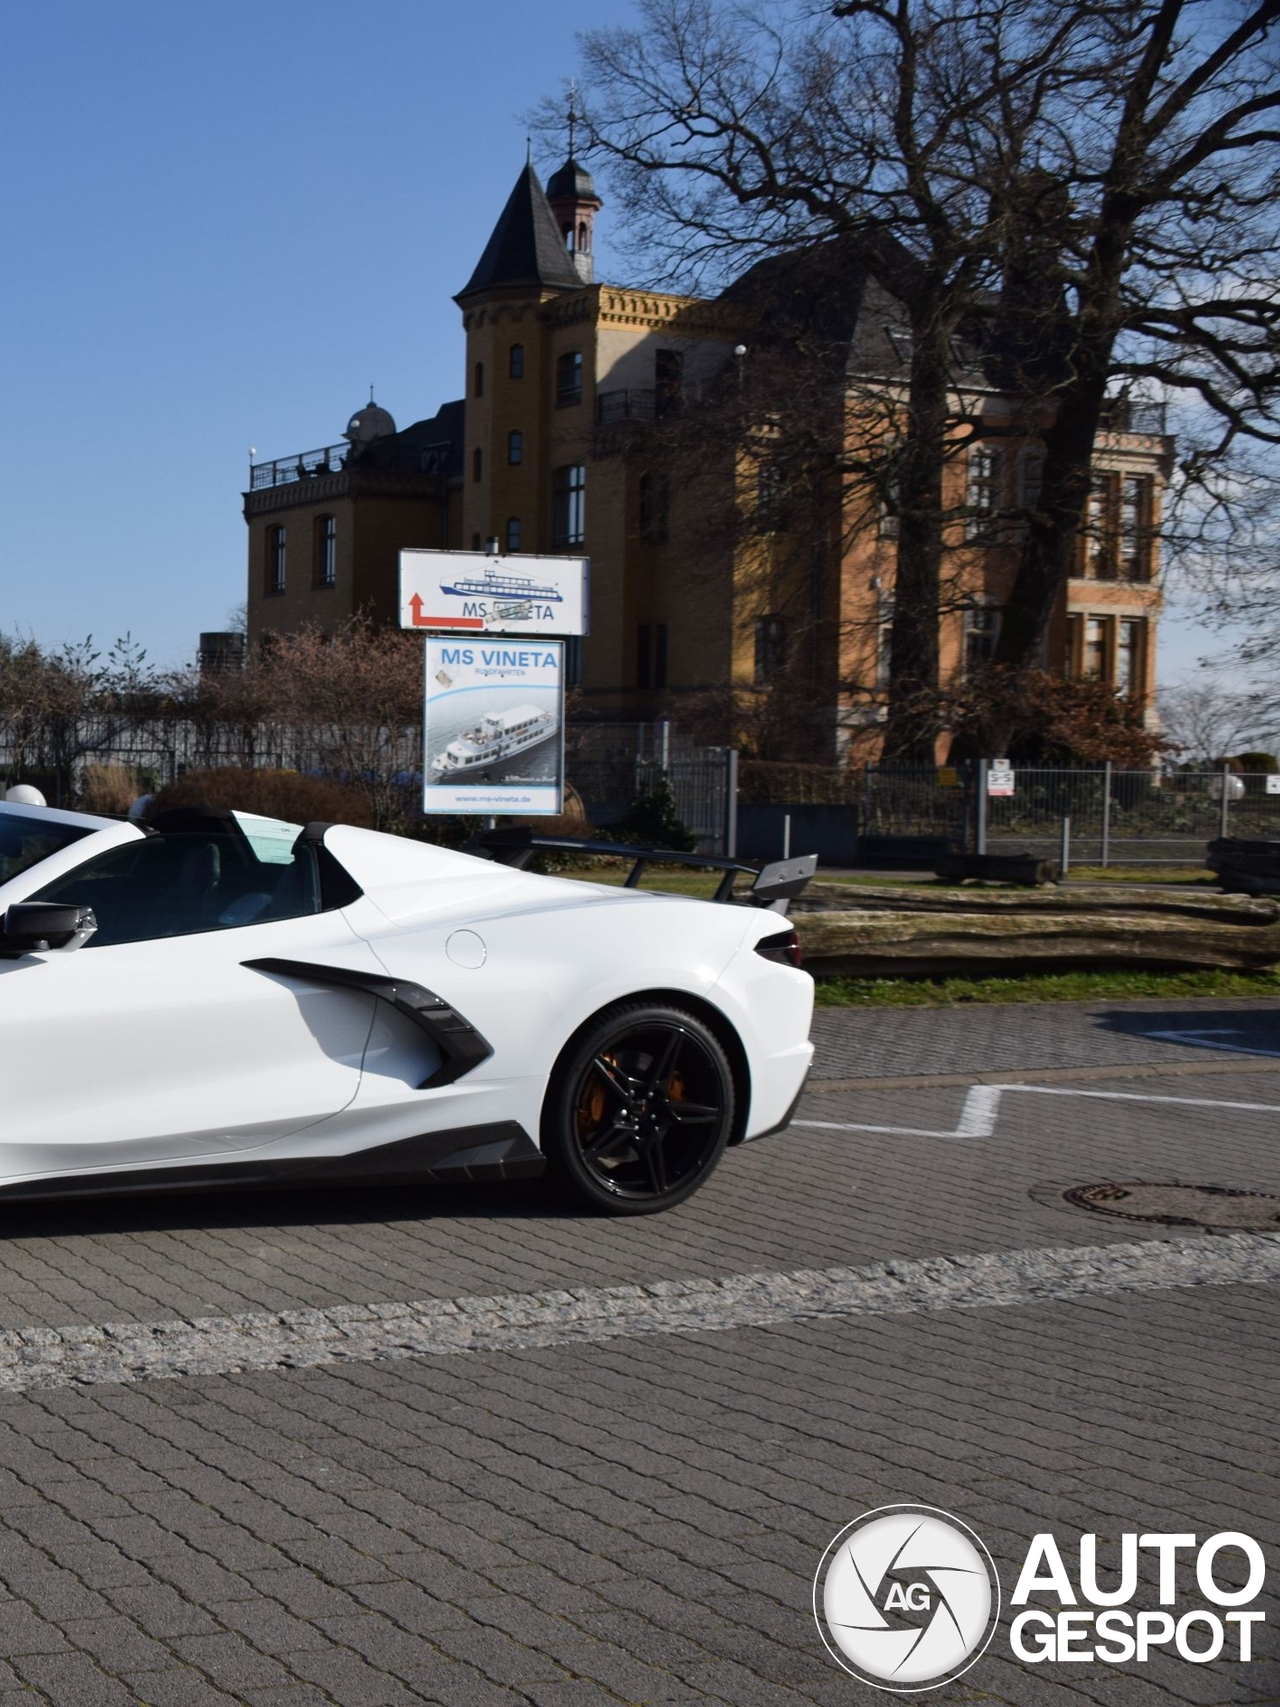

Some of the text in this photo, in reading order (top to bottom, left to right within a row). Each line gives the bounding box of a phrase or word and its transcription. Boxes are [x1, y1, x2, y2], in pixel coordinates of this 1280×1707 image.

[463, 602, 487, 617] MS
[441, 648, 558, 668] MS VINETA
[475, 668, 526, 676] RUNDFAHRTEN
[455, 795, 531, 803] www.ms-vineta.de
